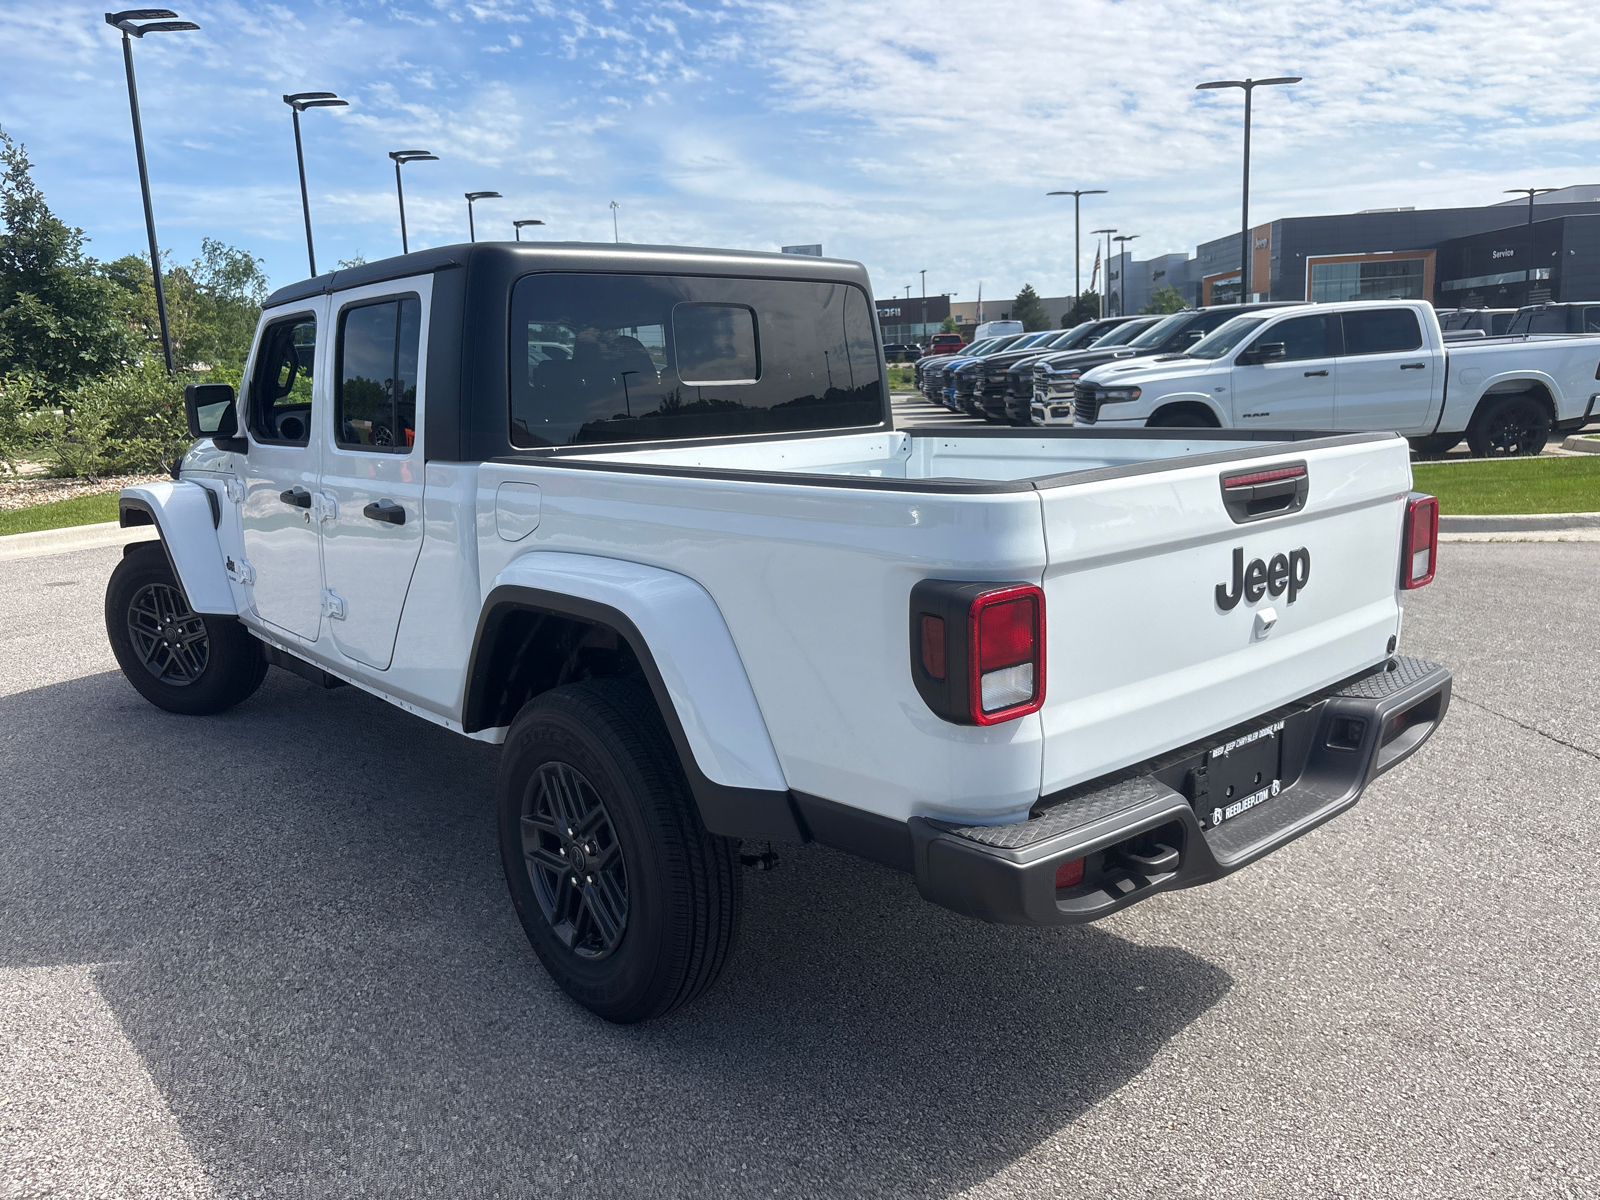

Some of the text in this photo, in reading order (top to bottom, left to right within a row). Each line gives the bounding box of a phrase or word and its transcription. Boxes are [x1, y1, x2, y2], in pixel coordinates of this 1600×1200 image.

[1492, 248, 1514, 259] Service
[1215, 546, 1310, 611] Jeep
[1273, 720, 1285, 732] RAM
[1225, 788, 1269, 820] REEDJEEP.COM
